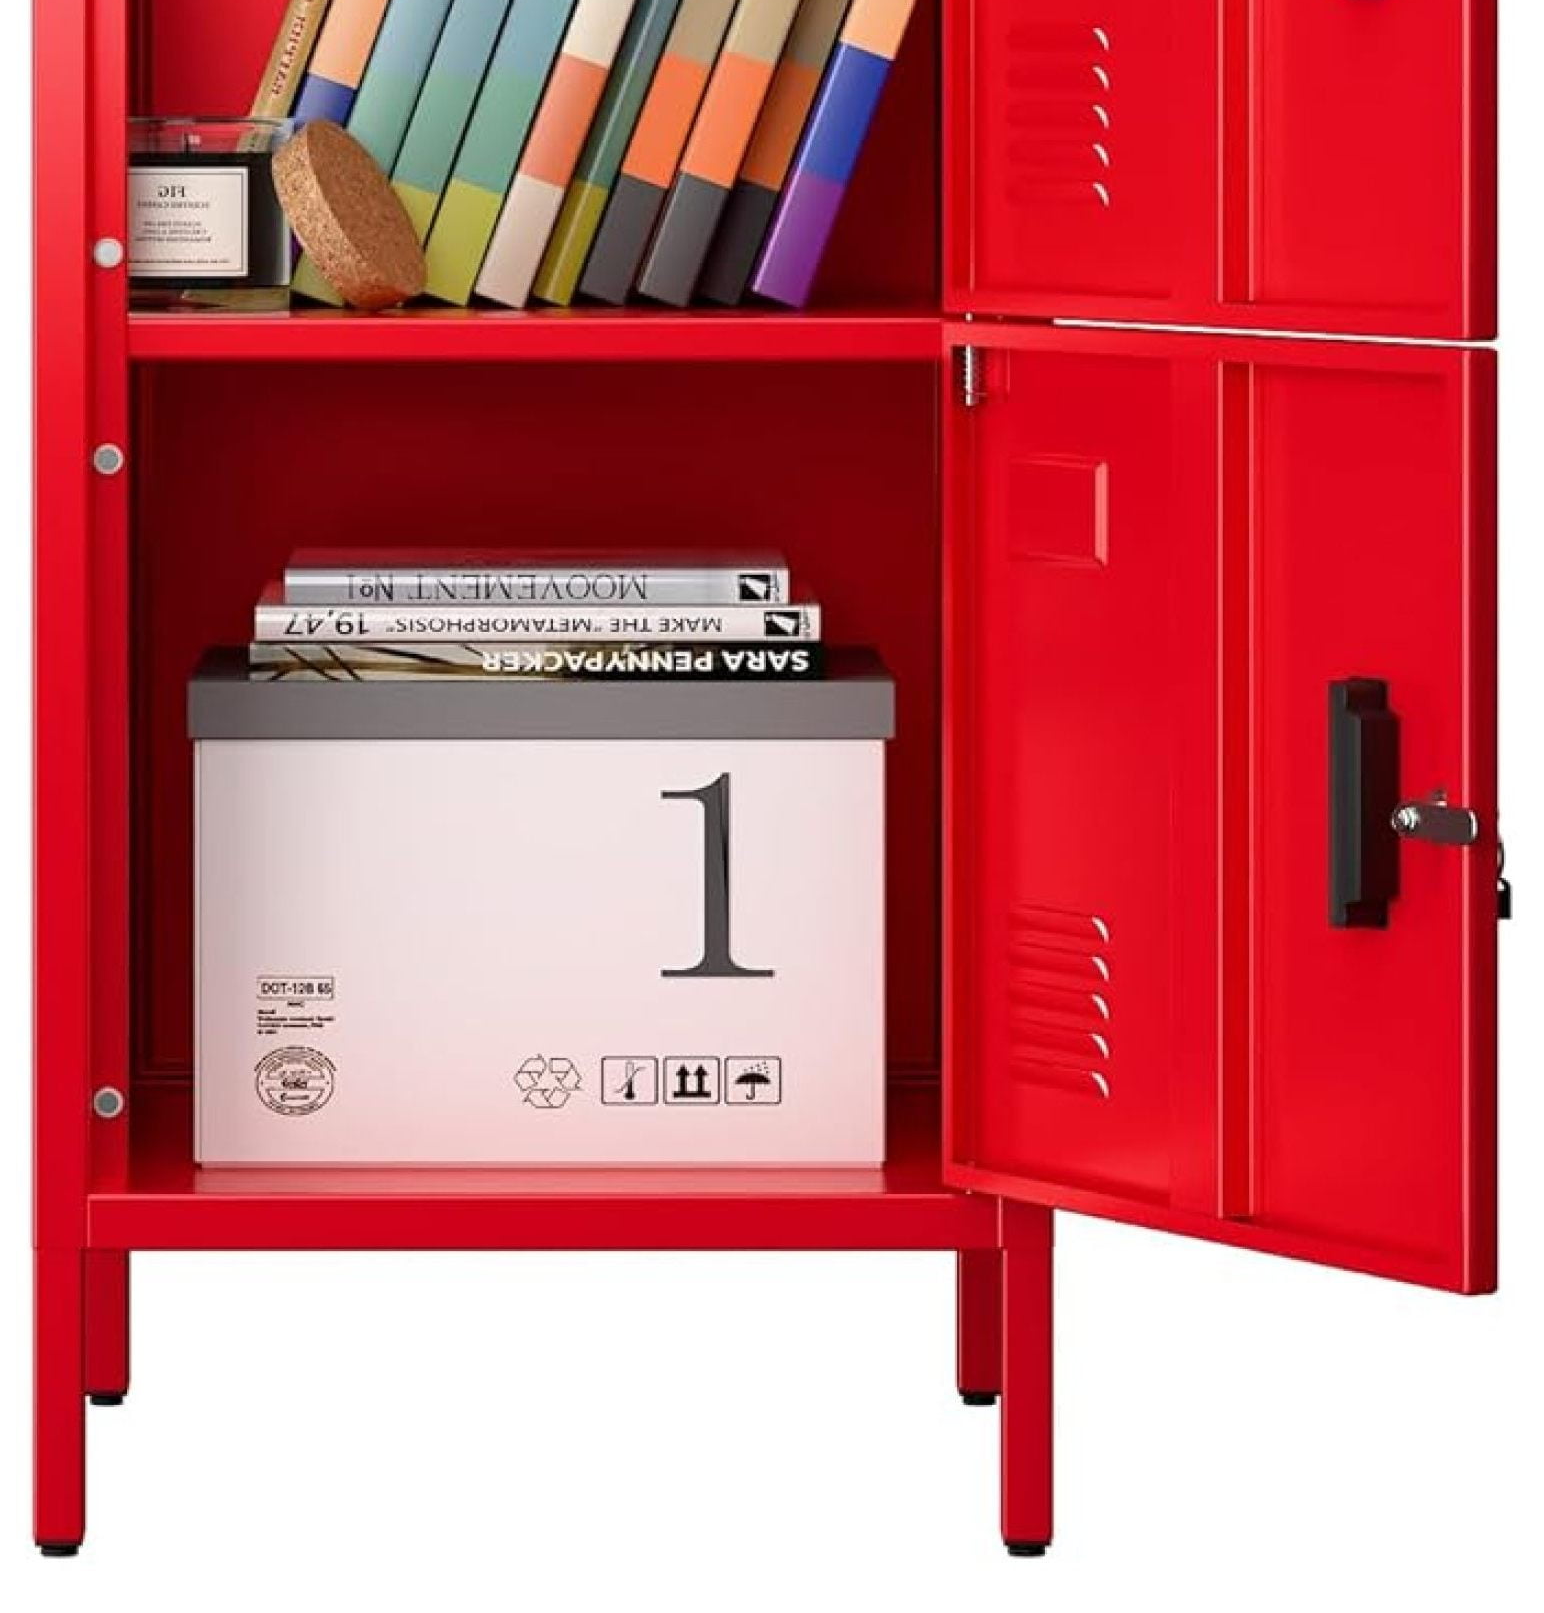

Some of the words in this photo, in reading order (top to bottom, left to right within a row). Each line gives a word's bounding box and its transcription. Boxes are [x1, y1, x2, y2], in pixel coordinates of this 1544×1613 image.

[408, 574, 648, 600] MOOVEMENT
[284, 609, 371, 636] 19,47
[609, 617, 652, 633] THE
[658, 617, 723, 633] MAKE
[482, 649, 713, 673] PENNYPACKER
[722, 649, 811, 673] SARA
[661, 772, 776, 978] 1
